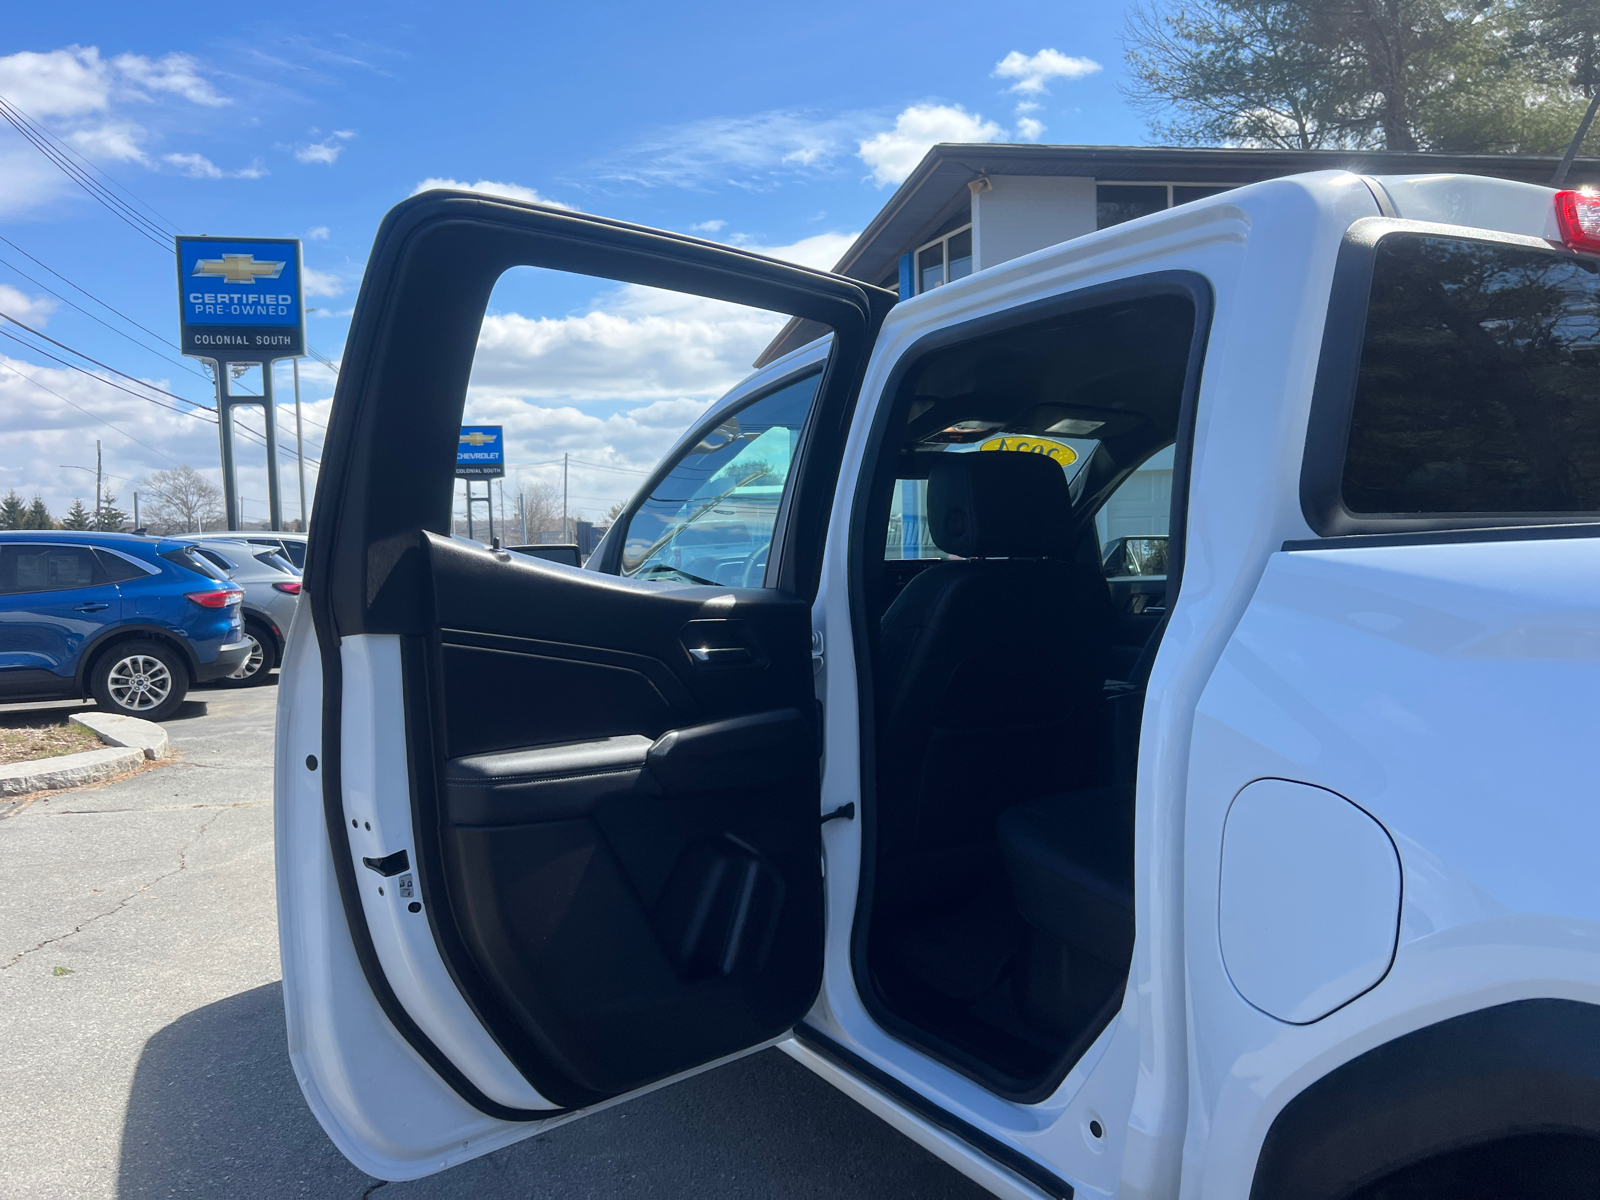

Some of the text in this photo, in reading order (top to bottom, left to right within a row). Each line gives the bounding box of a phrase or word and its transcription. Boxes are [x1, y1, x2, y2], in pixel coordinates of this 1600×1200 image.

[189, 293, 292, 305] CERTIFIED
[195, 304, 288, 316] PRE-OWNED
[194, 335, 291, 345] COLONIAL SOUTH
[457, 452, 500, 460] CHEVROLET
